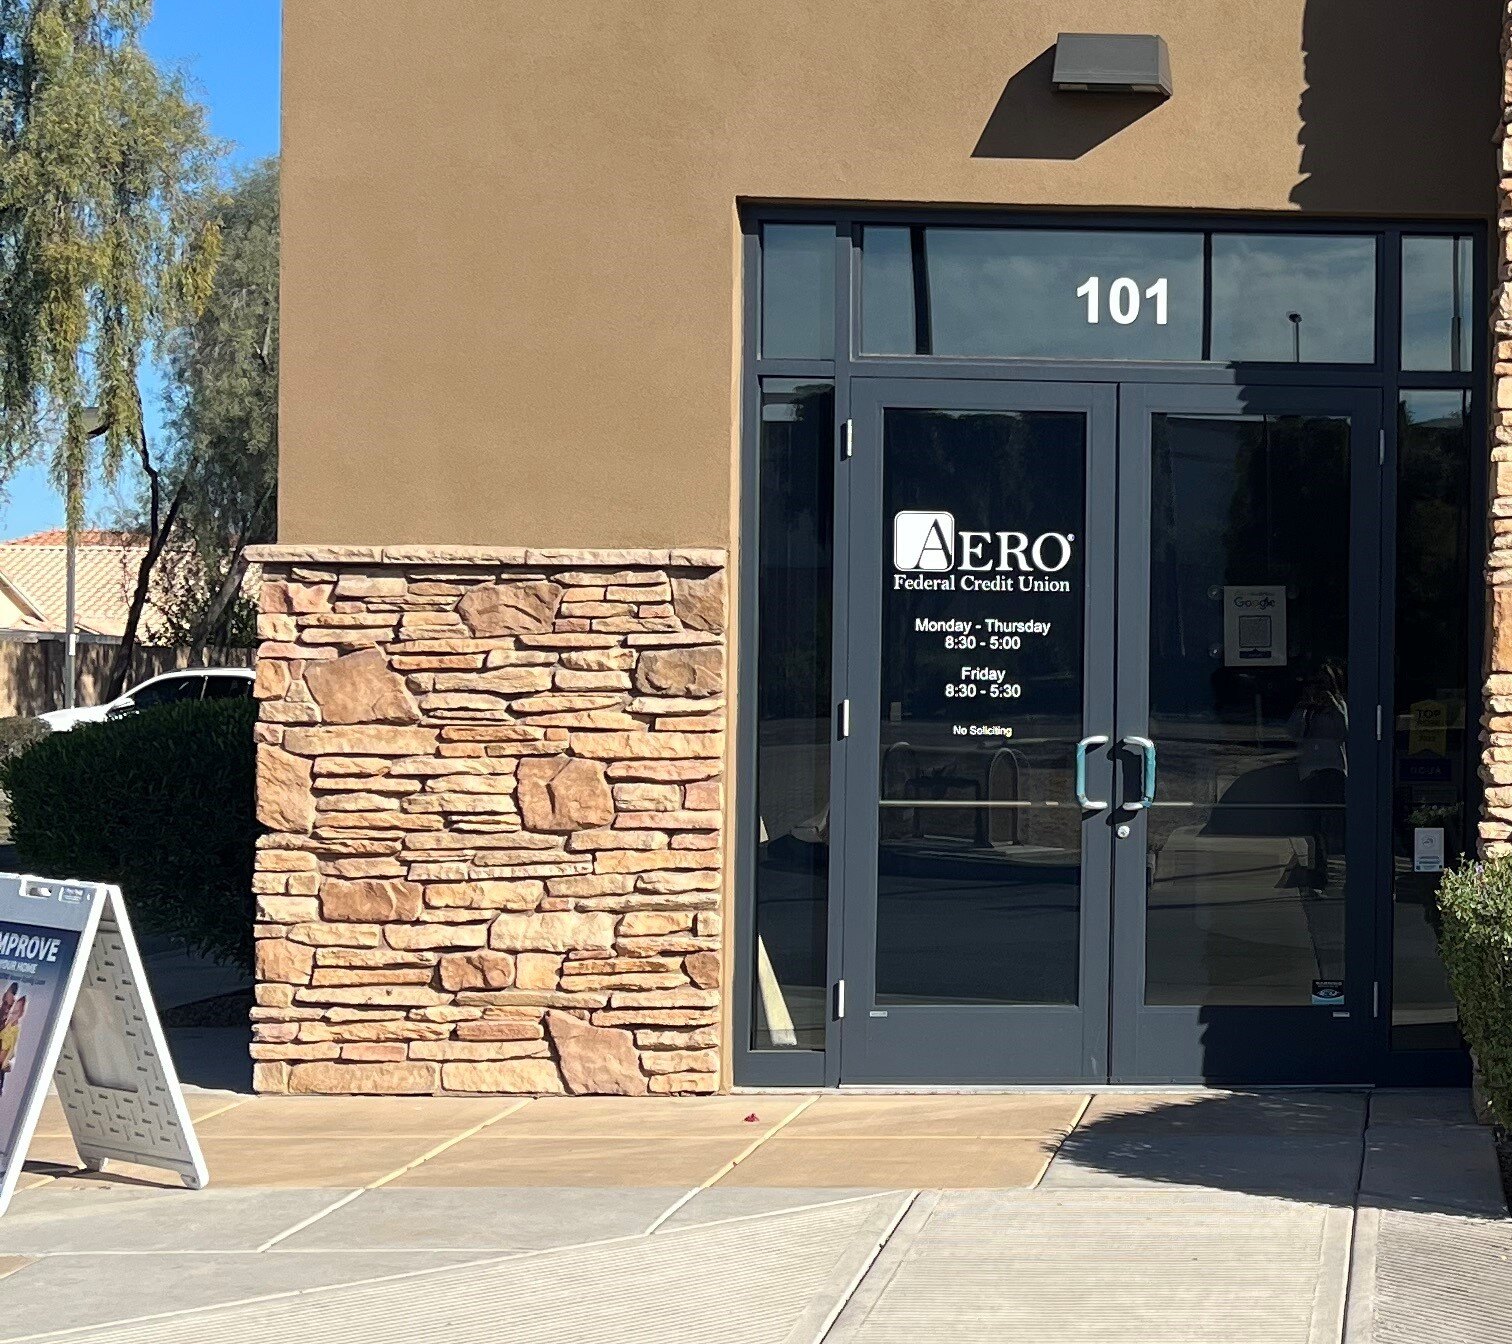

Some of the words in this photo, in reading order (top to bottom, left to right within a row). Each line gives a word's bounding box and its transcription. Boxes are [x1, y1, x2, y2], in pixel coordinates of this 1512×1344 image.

[1075, 276, 1168, 325] 101
[911, 518, 1072, 573] AERO
[893, 573, 956, 591] Federal
[960, 574, 1014, 592] Credit
[1018, 574, 1071, 592] Union
[914, 618, 973, 635] Monday
[985, 618, 1051, 636] Thursday
[944, 635, 977, 650] 8:30
[989, 635, 1021, 650] 5:00
[961, 666, 1006, 684] Friday
[944, 683, 977, 698] 8:30
[989, 683, 1021, 698] 5:30
[952, 725, 968, 736] No
[969, 725, 1013, 738] Soliciting
